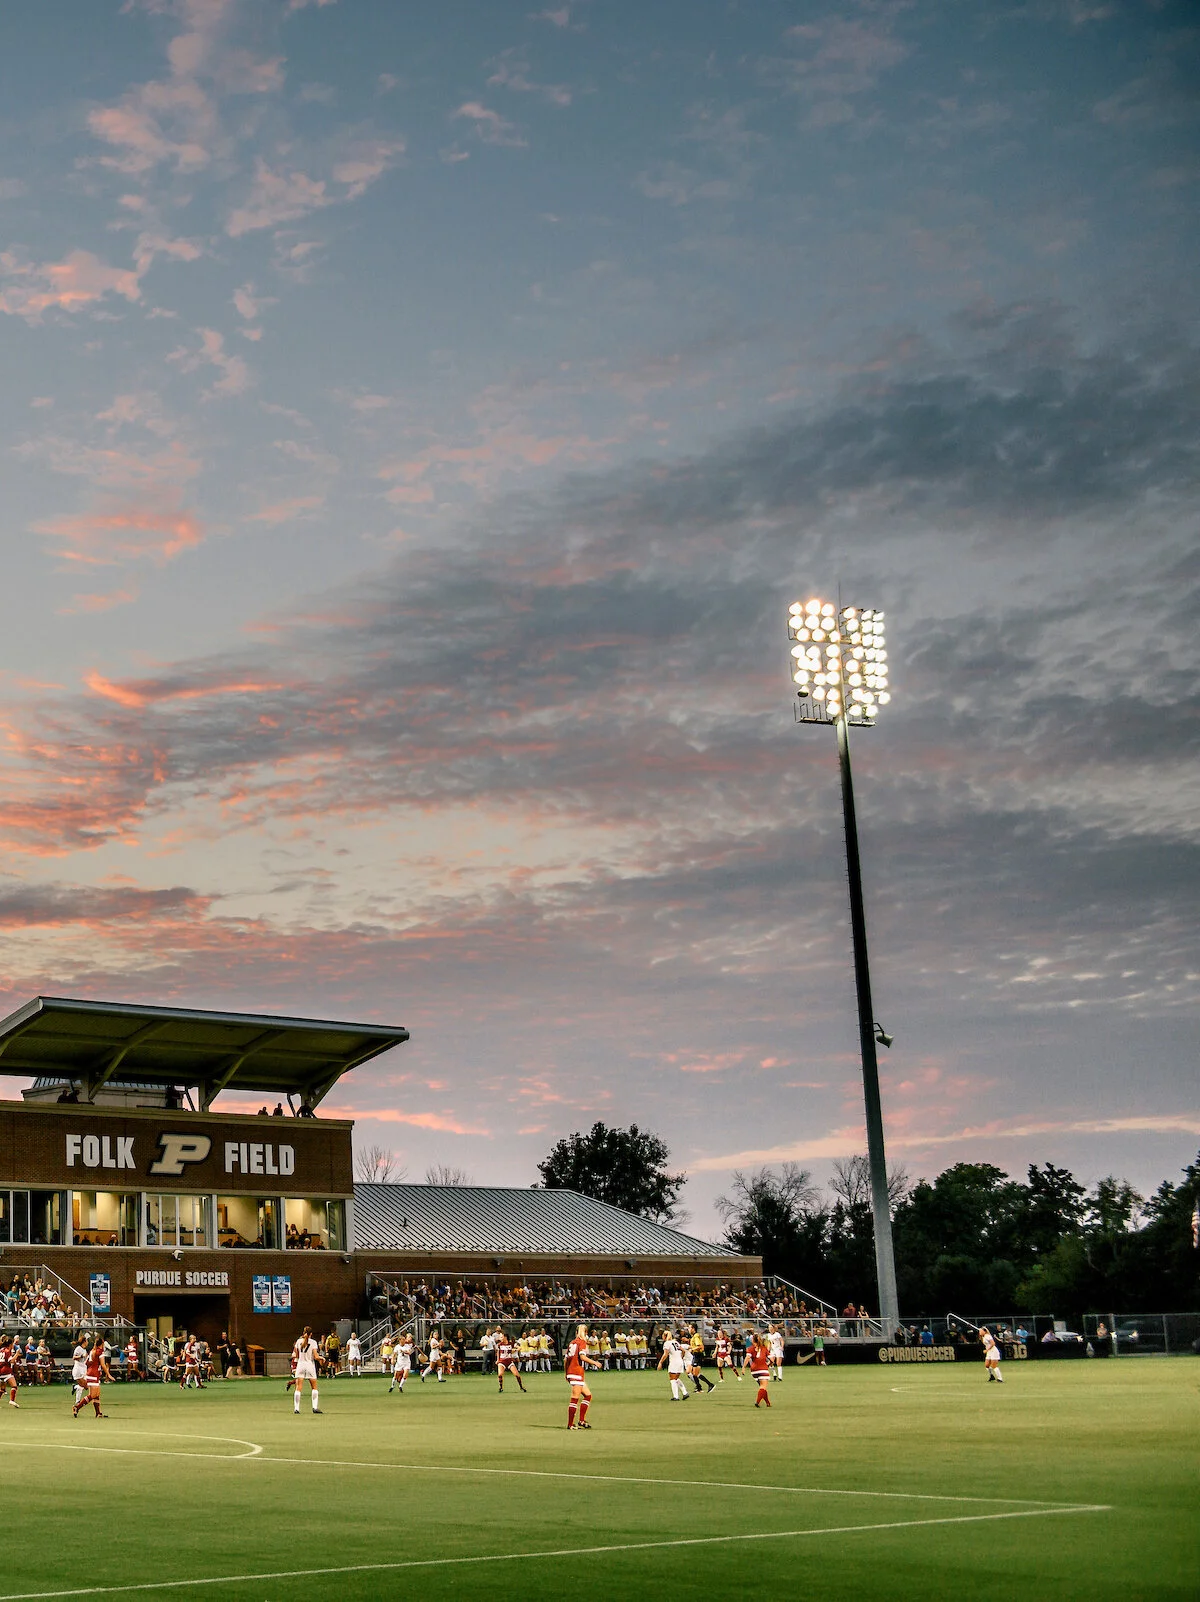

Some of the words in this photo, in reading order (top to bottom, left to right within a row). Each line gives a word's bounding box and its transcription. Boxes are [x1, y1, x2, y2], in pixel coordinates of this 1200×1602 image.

[65, 1133, 137, 1169] FOLK
[148, 1132, 212, 1177] P
[224, 1141, 295, 1176] FIELD
[136, 1270, 181, 1286] PURDUE
[185, 1271, 229, 1286] SOCCER
[878, 1345, 955, 1362] @PURDUESOCCER
